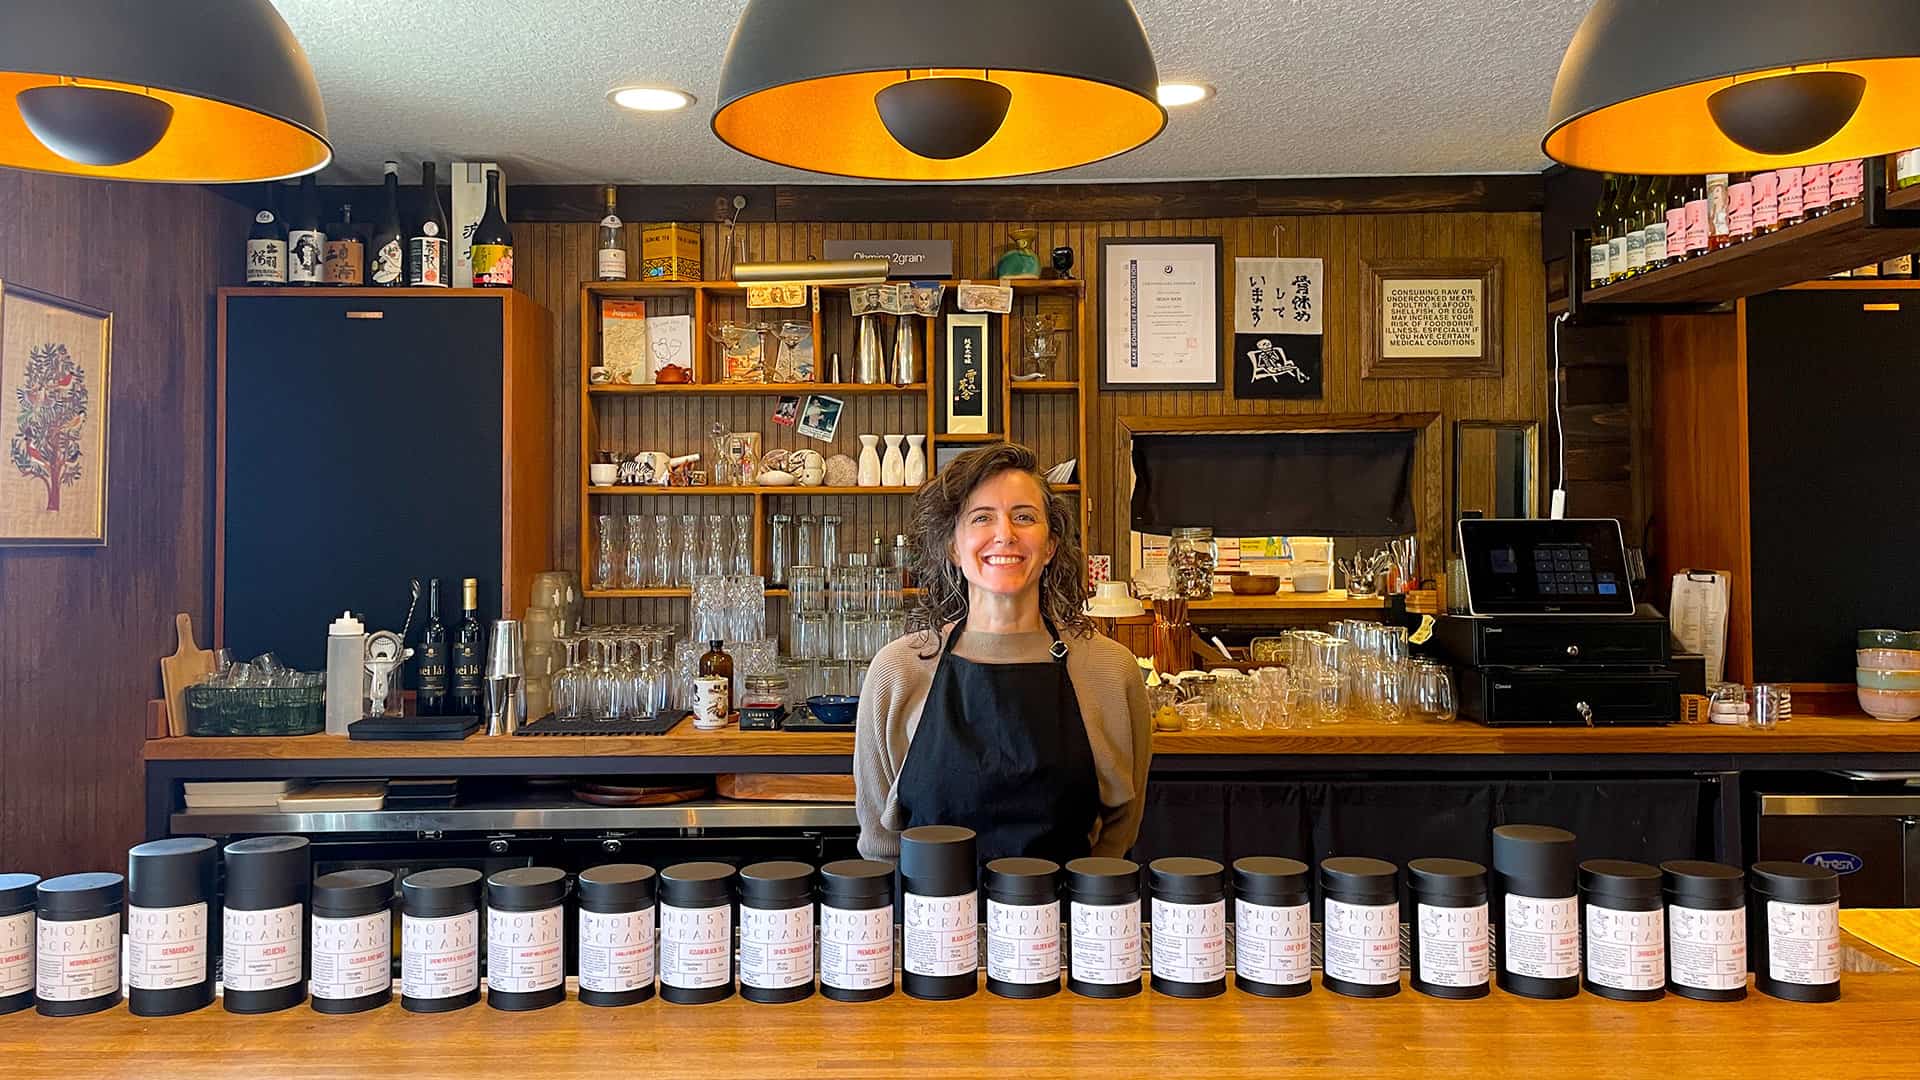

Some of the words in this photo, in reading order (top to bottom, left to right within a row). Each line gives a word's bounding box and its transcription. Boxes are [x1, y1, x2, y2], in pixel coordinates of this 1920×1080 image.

[1249, 275, 1266, 328] います
[1272, 287, 1286, 318] して
[1292, 275, 1312, 323] 骨休め
[928, 900, 973, 912] NOIS
[1535, 903, 1572, 915] NOI
[927, 913, 973, 928] CRAN
[1006, 908, 1055, 921] NOIS
[1095, 908, 1137, 921] NOIS
[1172, 908, 1220, 921] NOIS
[1255, 911, 1304, 922] NOIS
[1350, 910, 1394, 922] NOIS
[1614, 914, 1660, 927] NOIS
[1172, 922, 1221, 935] CRAN
[1348, 923, 1395, 937] CRAN
[1535, 918, 1572, 930] CRA
[1447, 925, 1484, 937] CRA
